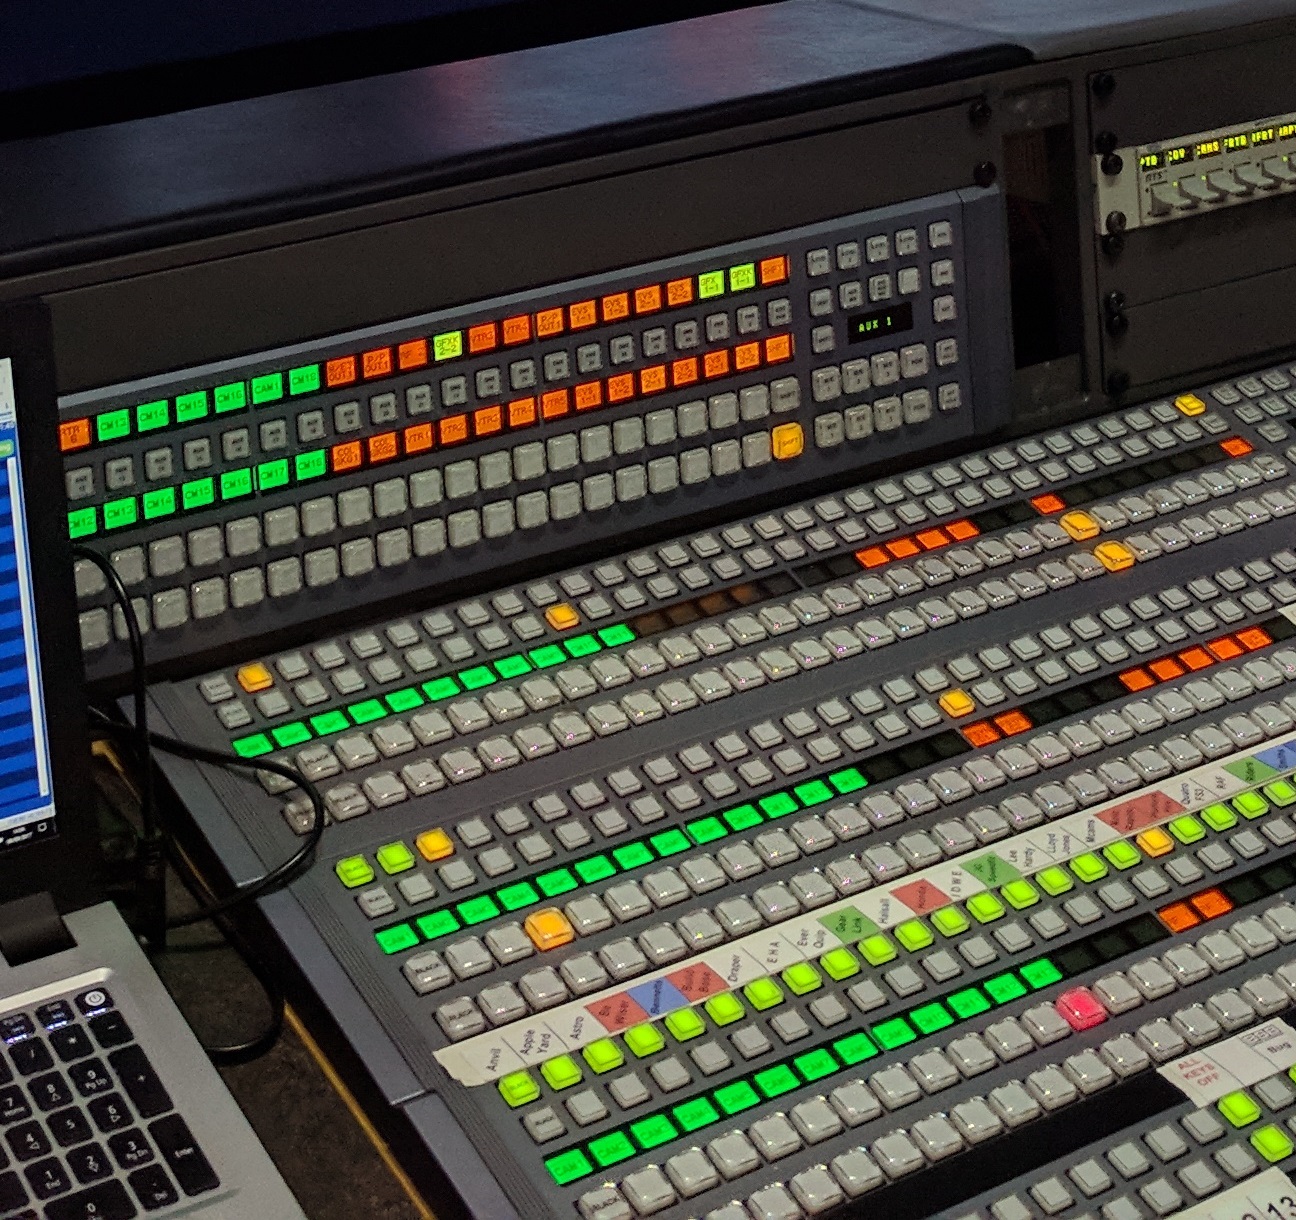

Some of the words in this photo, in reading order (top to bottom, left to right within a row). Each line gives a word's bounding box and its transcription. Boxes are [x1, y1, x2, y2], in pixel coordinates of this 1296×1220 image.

[858, 319, 879, 332] AUX
[886, 316, 892, 326] 1
[797, 928, 810, 947] Ever
[728, 954, 741, 982] Draper
[569, 1015, 585, 1040] Astro
[520, 1028, 536, 1055] Apple
[537, 1033, 552, 1054] Yard
[1267, 1040, 1292, 1053] Bug
[486, 1048, 502, 1072] Anvil
[1178, 1058, 1202, 1070] ALL
[87, 1070, 97, 1081] 9
[1183, 1063, 1215, 1080] KEYS
[1197, 1073, 1220, 1087] OFF
[109, 1105, 116, 1115] 6
[66, 1120, 75, 1130] 5
[25, 1134, 34, 1144] 4
[128, 1141, 137, 1151] 3
[87, 1202, 96, 1213] 0
